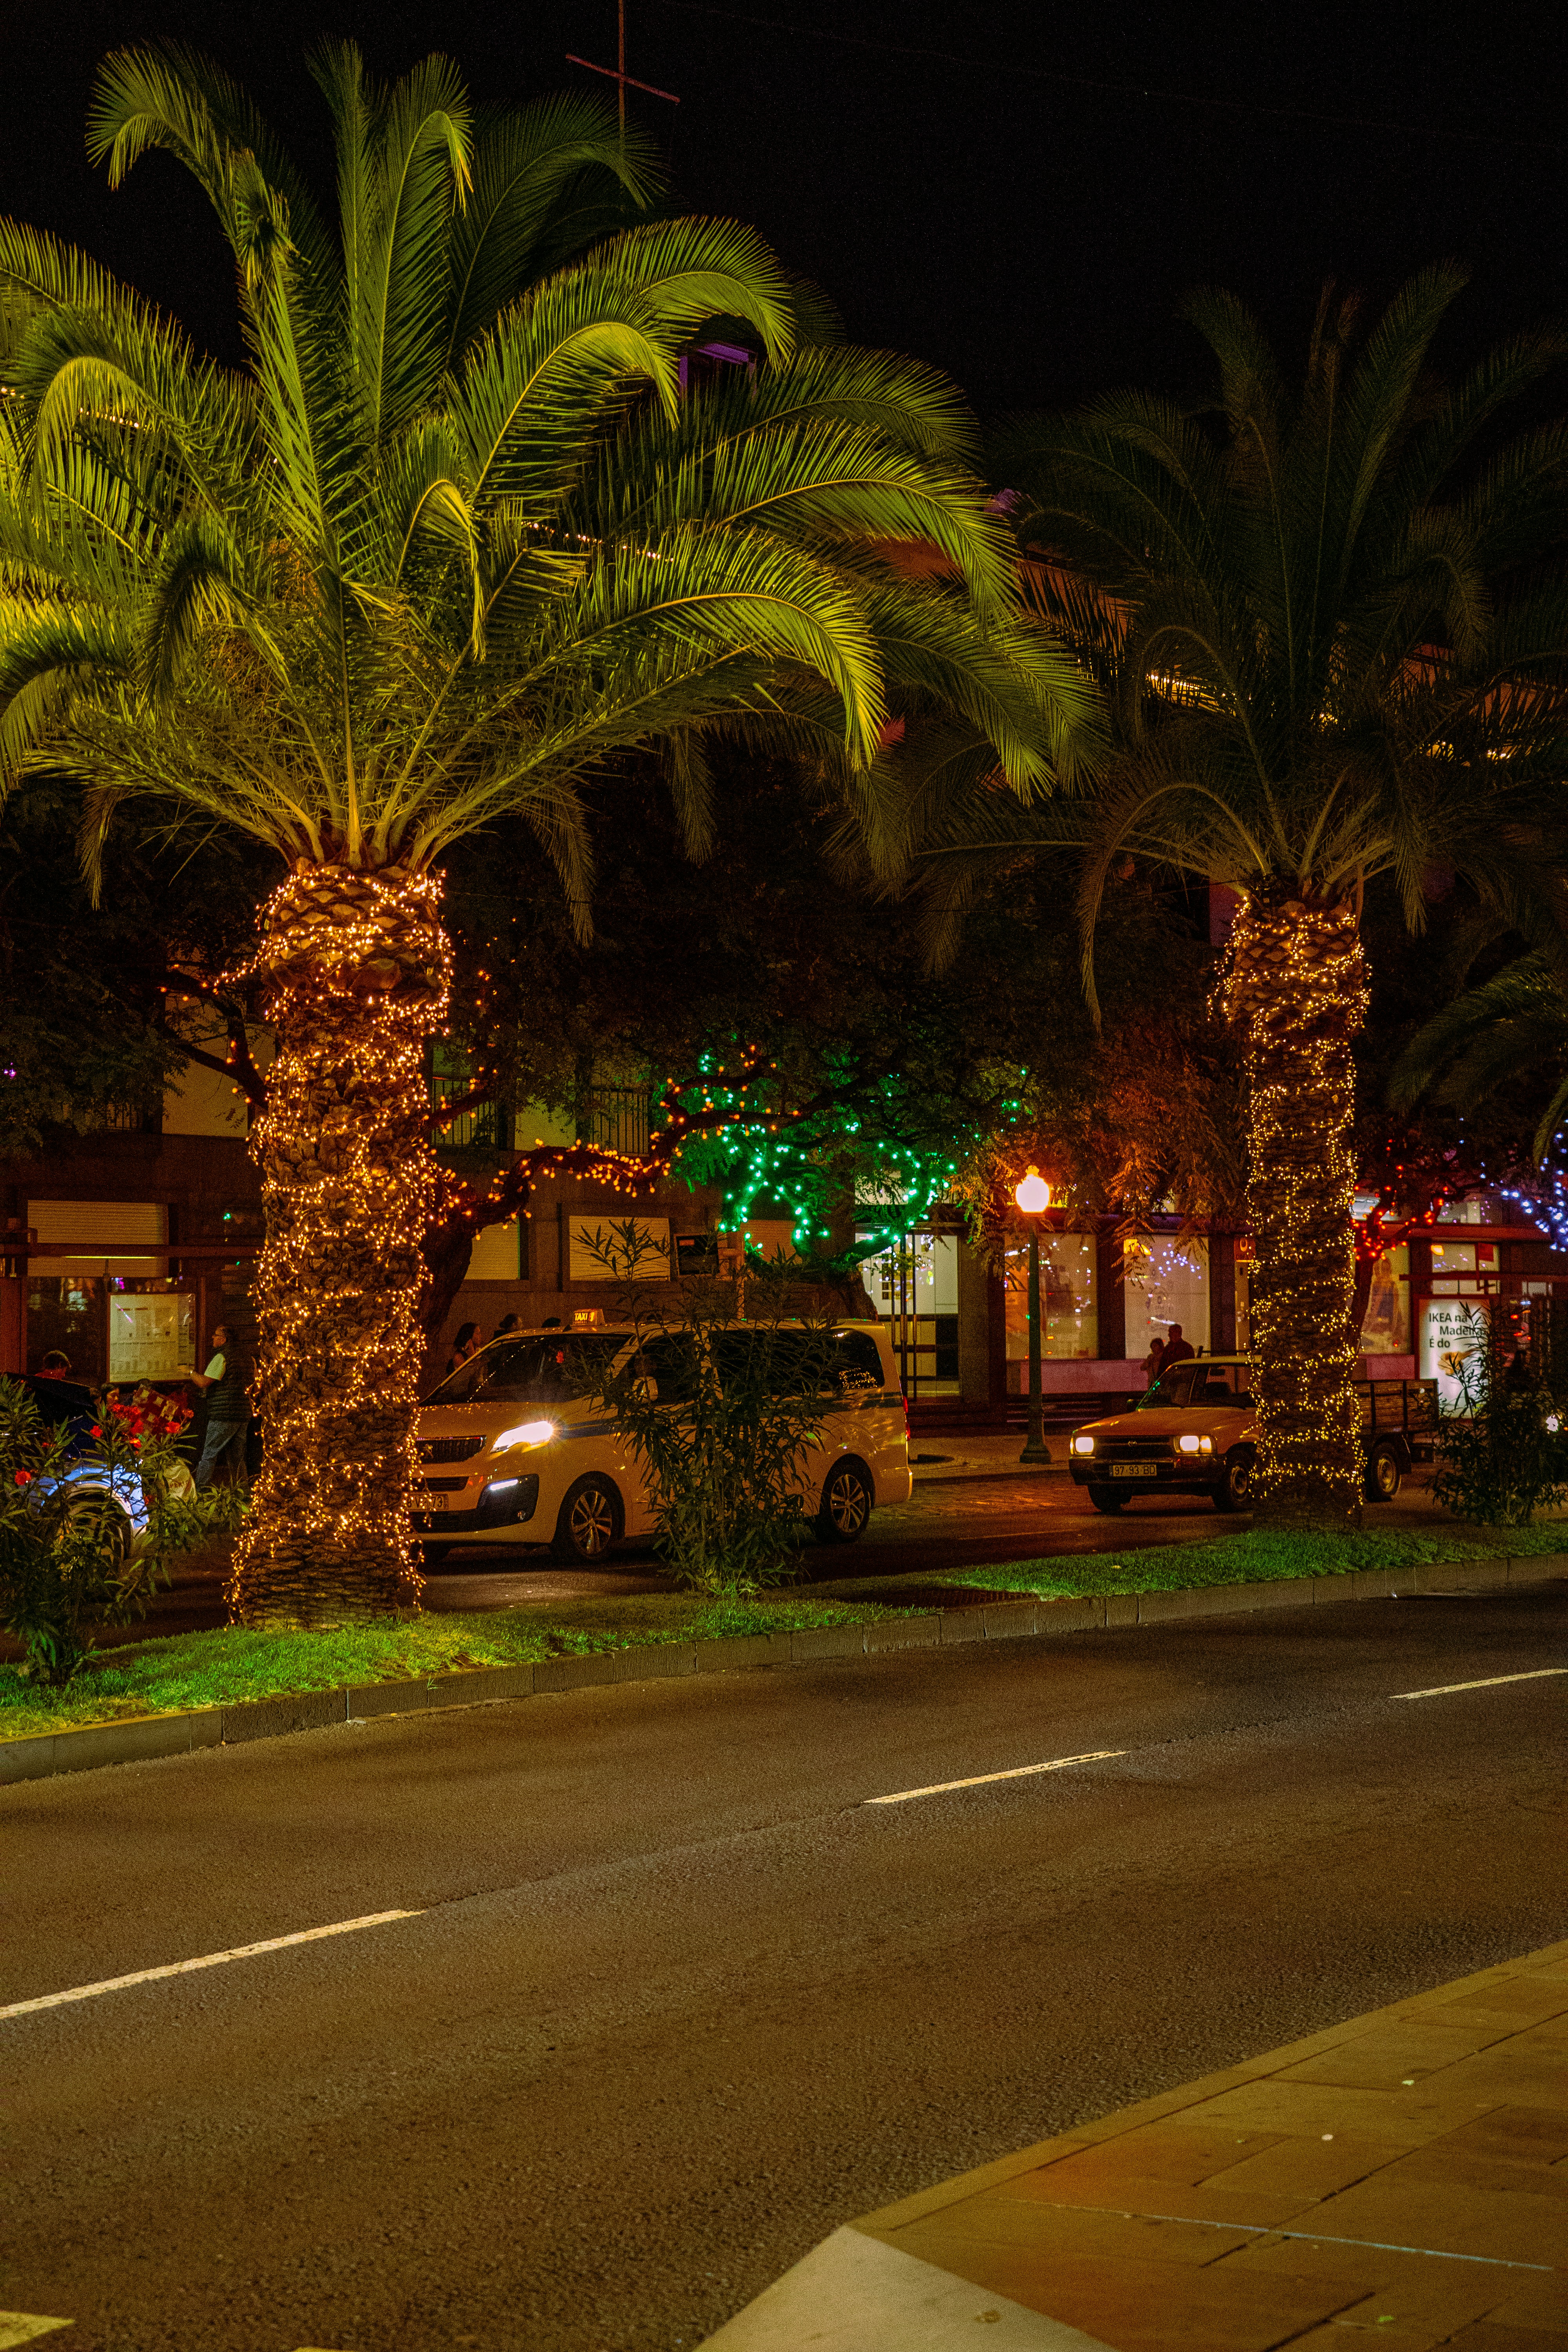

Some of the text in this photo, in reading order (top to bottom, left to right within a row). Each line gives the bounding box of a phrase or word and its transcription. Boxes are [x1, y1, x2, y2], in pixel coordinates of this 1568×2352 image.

[574, 1312, 588, 1321] TAXI
[1429, 1312, 1452, 1322] IKEA
[1429, 1336, 1450, 1348] É do
